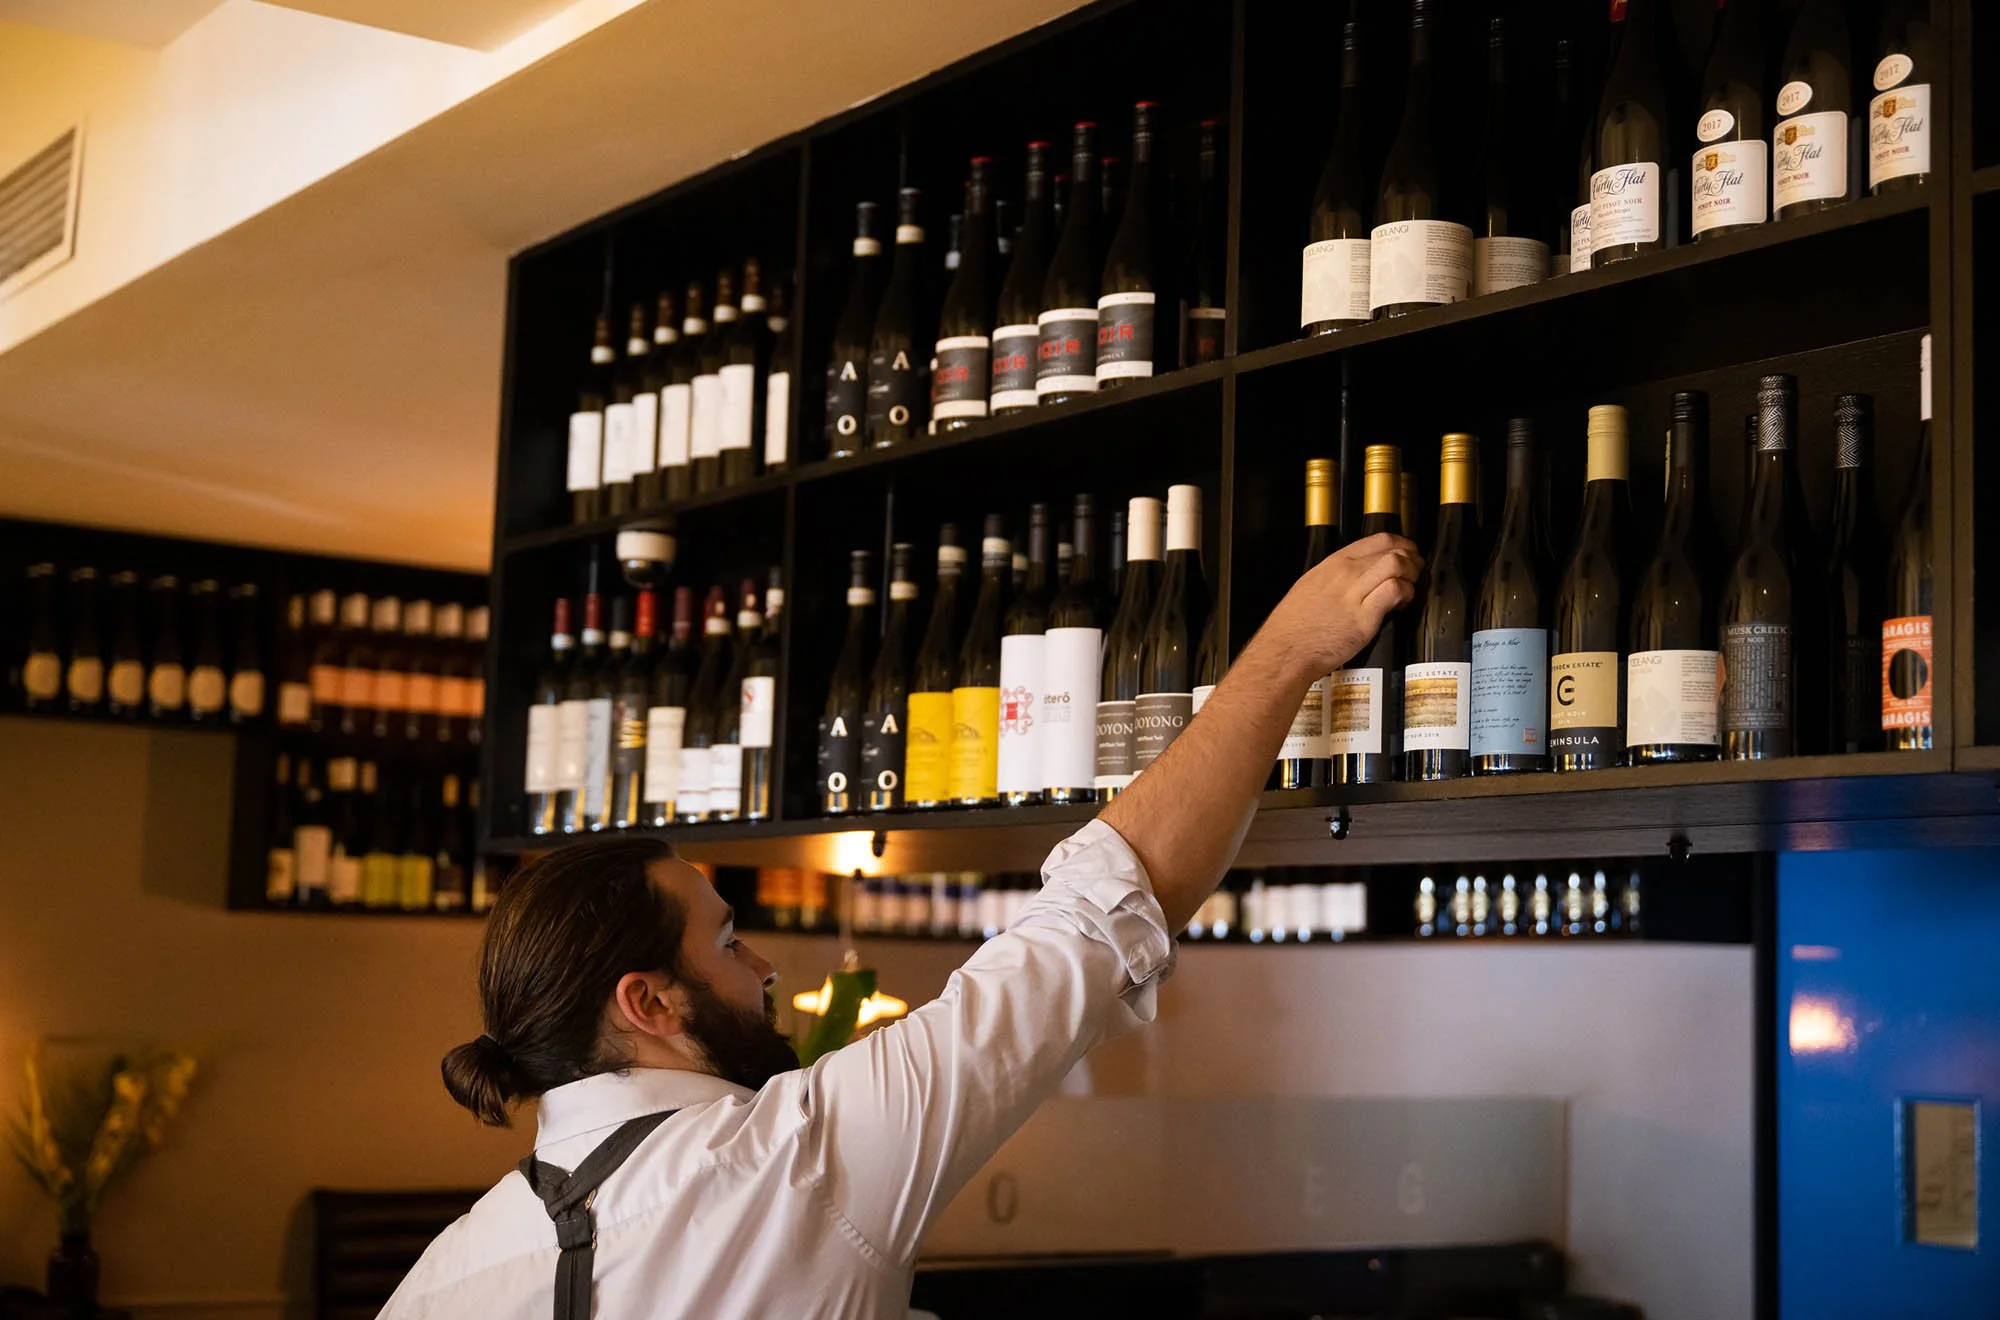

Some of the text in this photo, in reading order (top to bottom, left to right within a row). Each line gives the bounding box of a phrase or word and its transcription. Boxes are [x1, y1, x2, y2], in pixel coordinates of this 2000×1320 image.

[1782, 91, 1801, 106] 2017
[1703, 119, 1721, 133] 2017
[1892, 117, 1924, 141] Flat
[1792, 143, 1823, 167] Flat
[1612, 169, 1647, 193] Flat
[1712, 170, 1745, 196] Flat
[1624, 198, 1643, 206] NOIR
[1713, 198, 1732, 206] NOIR
[840, 361, 858, 381] A
[892, 351, 910, 371] A
[837, 414, 857, 436] O
[889, 405, 909, 426] O
[1728, 626, 1787, 635] MUSK CREEK
[1572, 661, 1601, 669] ESTATE
[830, 716, 848, 738] A
[880, 713, 899, 734] A
[827, 771, 848, 793] O
[877, 770, 898, 791] O
